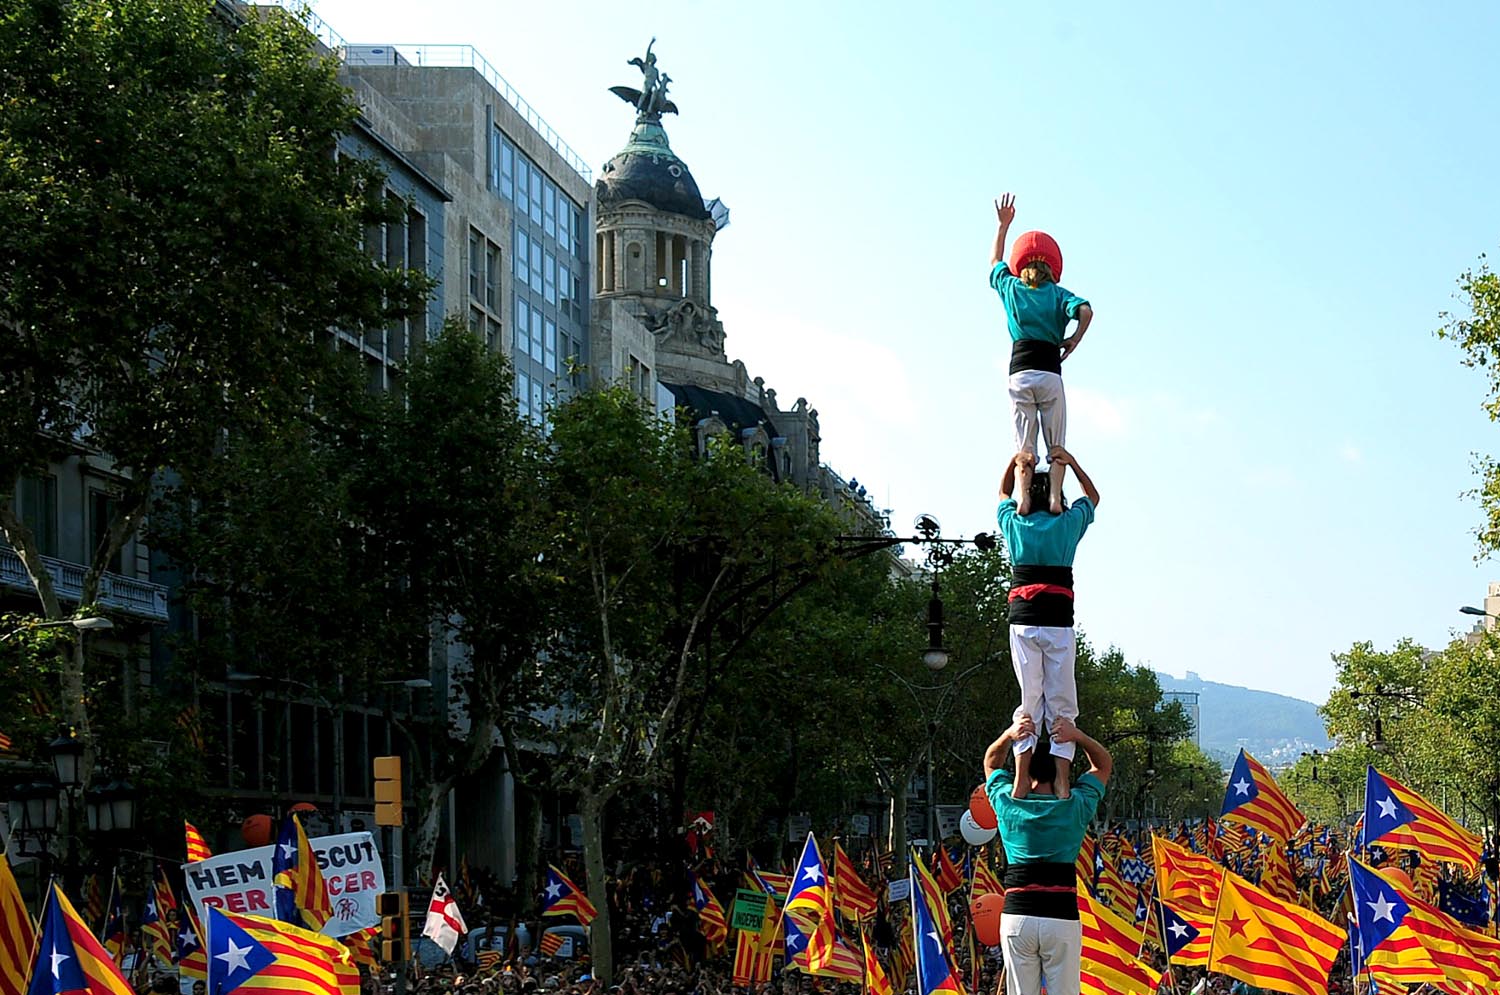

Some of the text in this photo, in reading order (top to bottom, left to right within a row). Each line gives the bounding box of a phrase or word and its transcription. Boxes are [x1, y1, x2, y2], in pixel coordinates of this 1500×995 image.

[189, 841, 374, 890] HEM SCUT
[201, 870, 377, 914] PER CER
